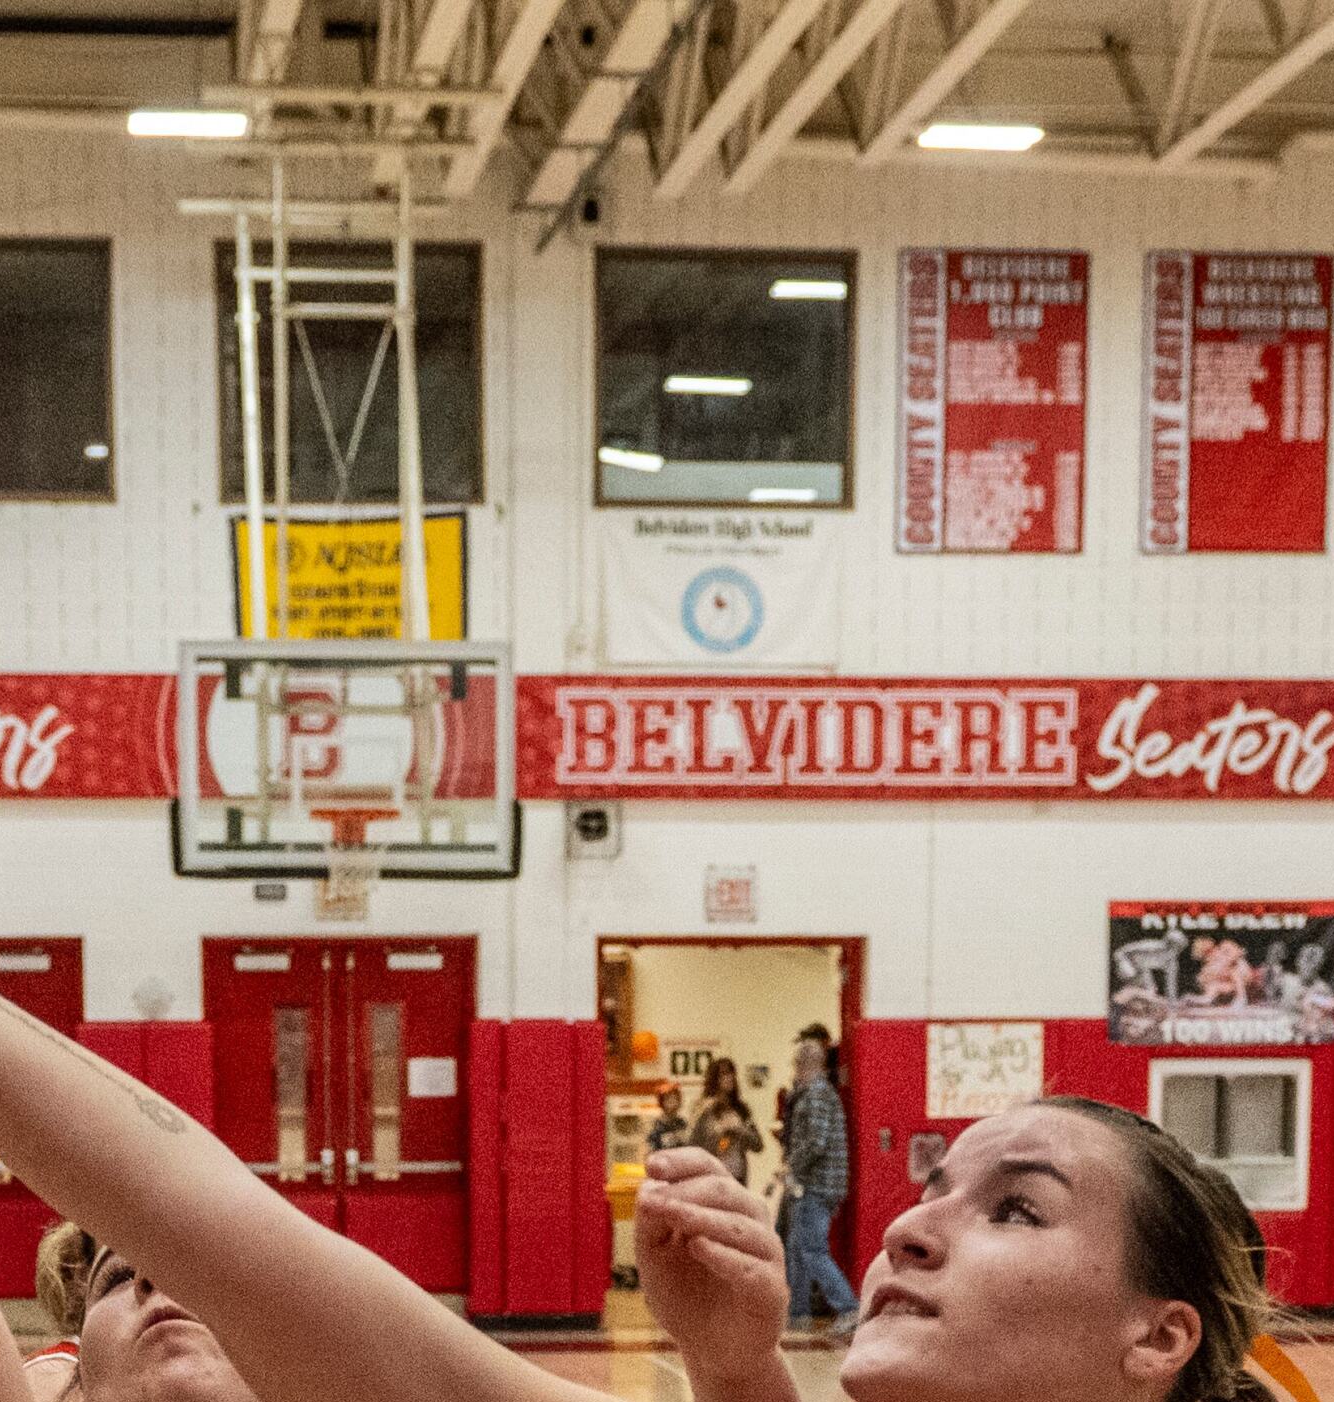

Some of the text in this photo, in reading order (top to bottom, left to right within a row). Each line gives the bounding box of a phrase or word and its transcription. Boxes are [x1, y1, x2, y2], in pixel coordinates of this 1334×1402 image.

[906, 254, 938, 545] COUNTY SEATERS
[1150, 256, 1183, 546] COUNTY SEATERS
[555, 687, 1078, 787] BELVIDERE
